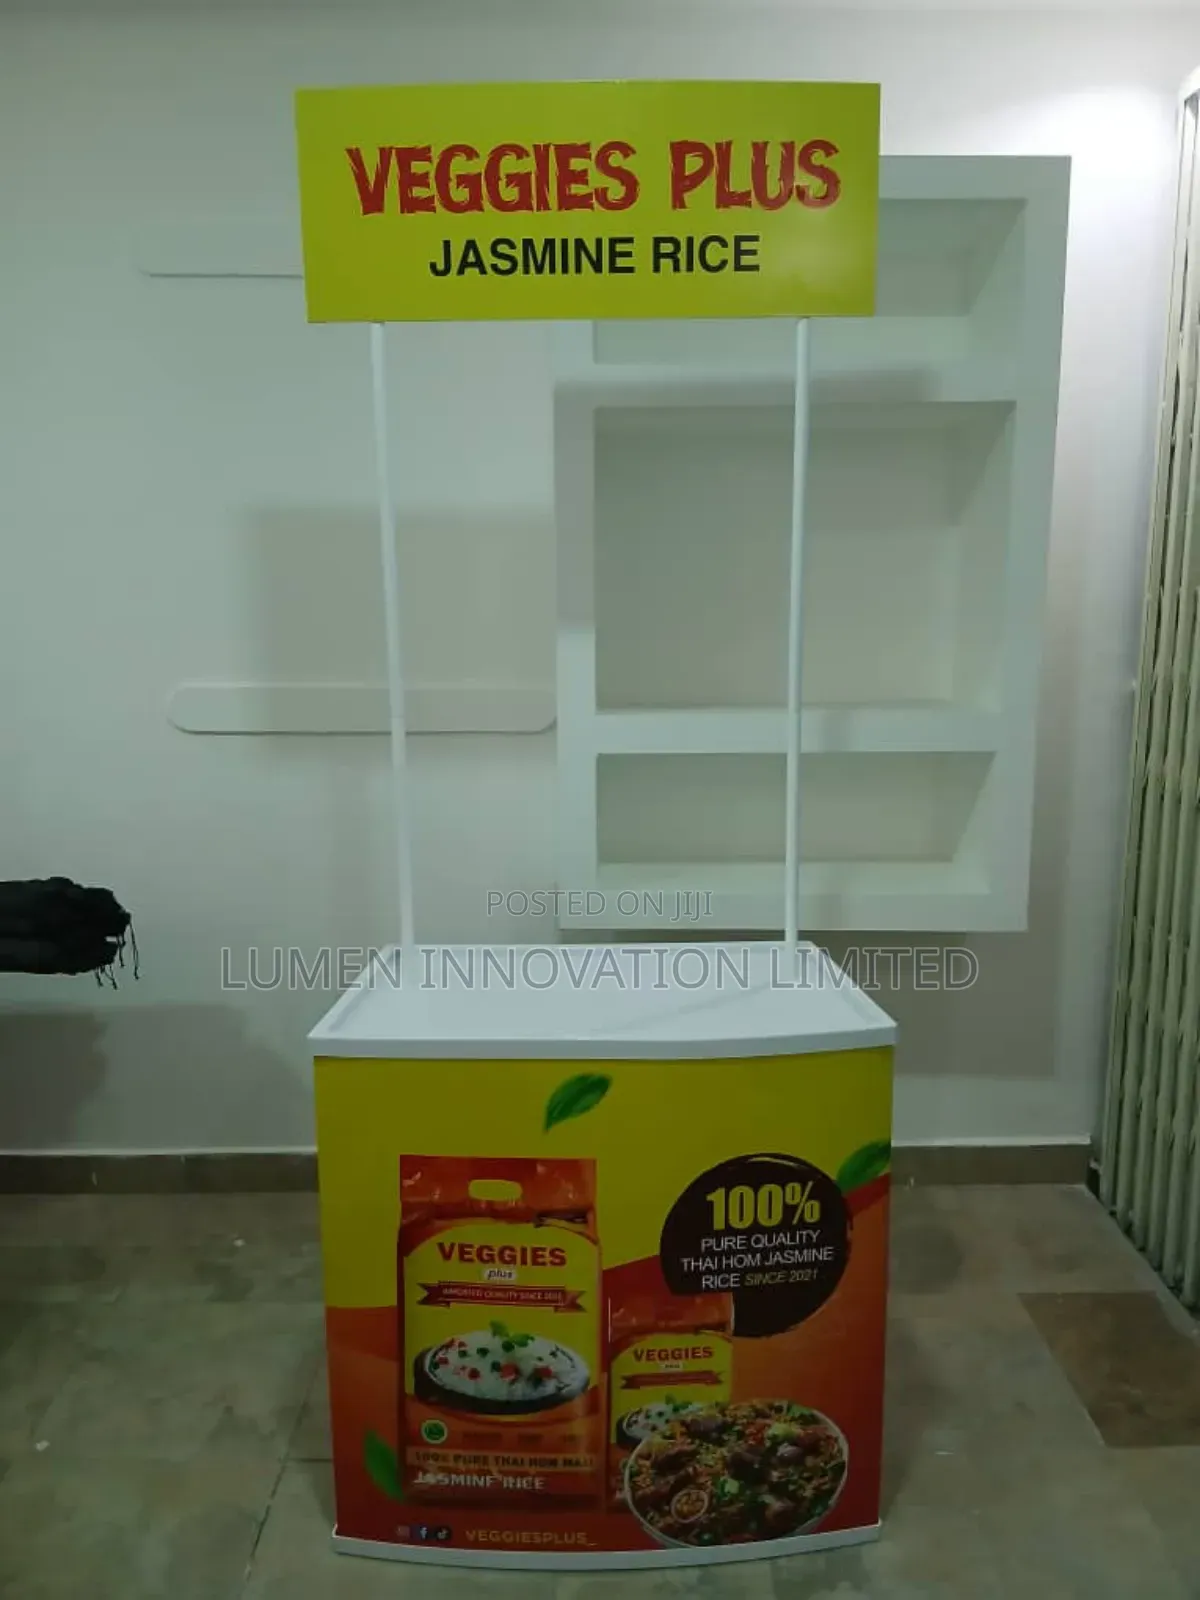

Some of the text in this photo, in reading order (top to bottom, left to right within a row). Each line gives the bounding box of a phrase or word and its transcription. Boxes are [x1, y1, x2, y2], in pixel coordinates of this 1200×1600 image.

[345, 140, 842, 216] VEGGIES PLUS
[429, 235, 760, 277] JASMINE RICE
[706, 1181, 820, 1231] 100%
[701, 1230, 821, 1253] PURE QUALITY
[437, 1242, 567, 1267] VEGGIES
[681, 1247, 834, 1272] THAI HOM JASMINE
[486, 1269, 513, 1280] plus
[702, 1267, 818, 1290] RICE SINCE 2021
[633, 1346, 713, 1362] VEGGIES
